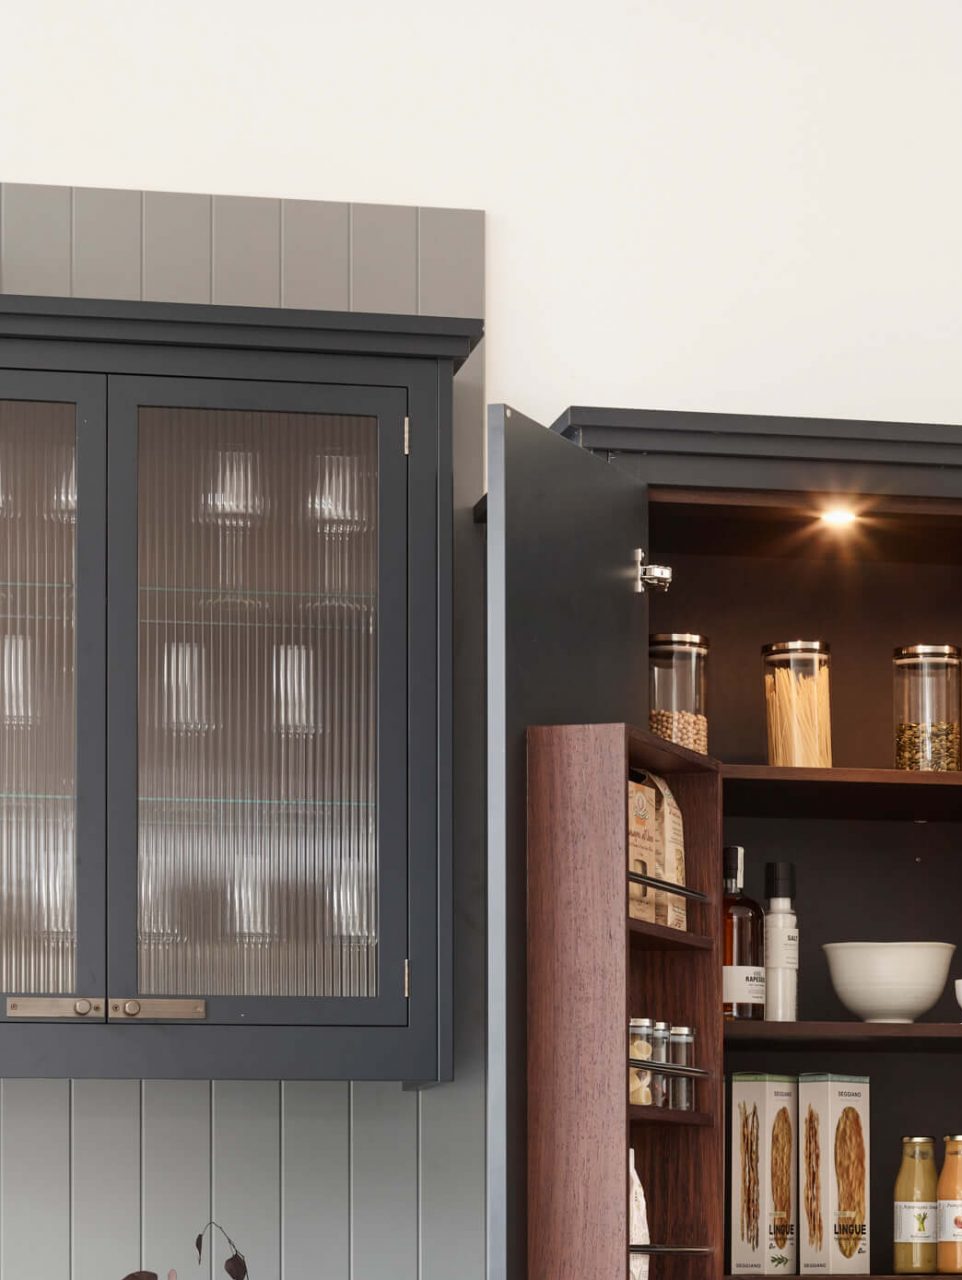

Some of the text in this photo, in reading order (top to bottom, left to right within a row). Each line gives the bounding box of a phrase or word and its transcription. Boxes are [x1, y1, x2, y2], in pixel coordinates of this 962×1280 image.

[787, 934, 798, 942] SALT
[769, 1224, 795, 1236] LINGUE
[833, 1224, 867, 1236] LINGUE
